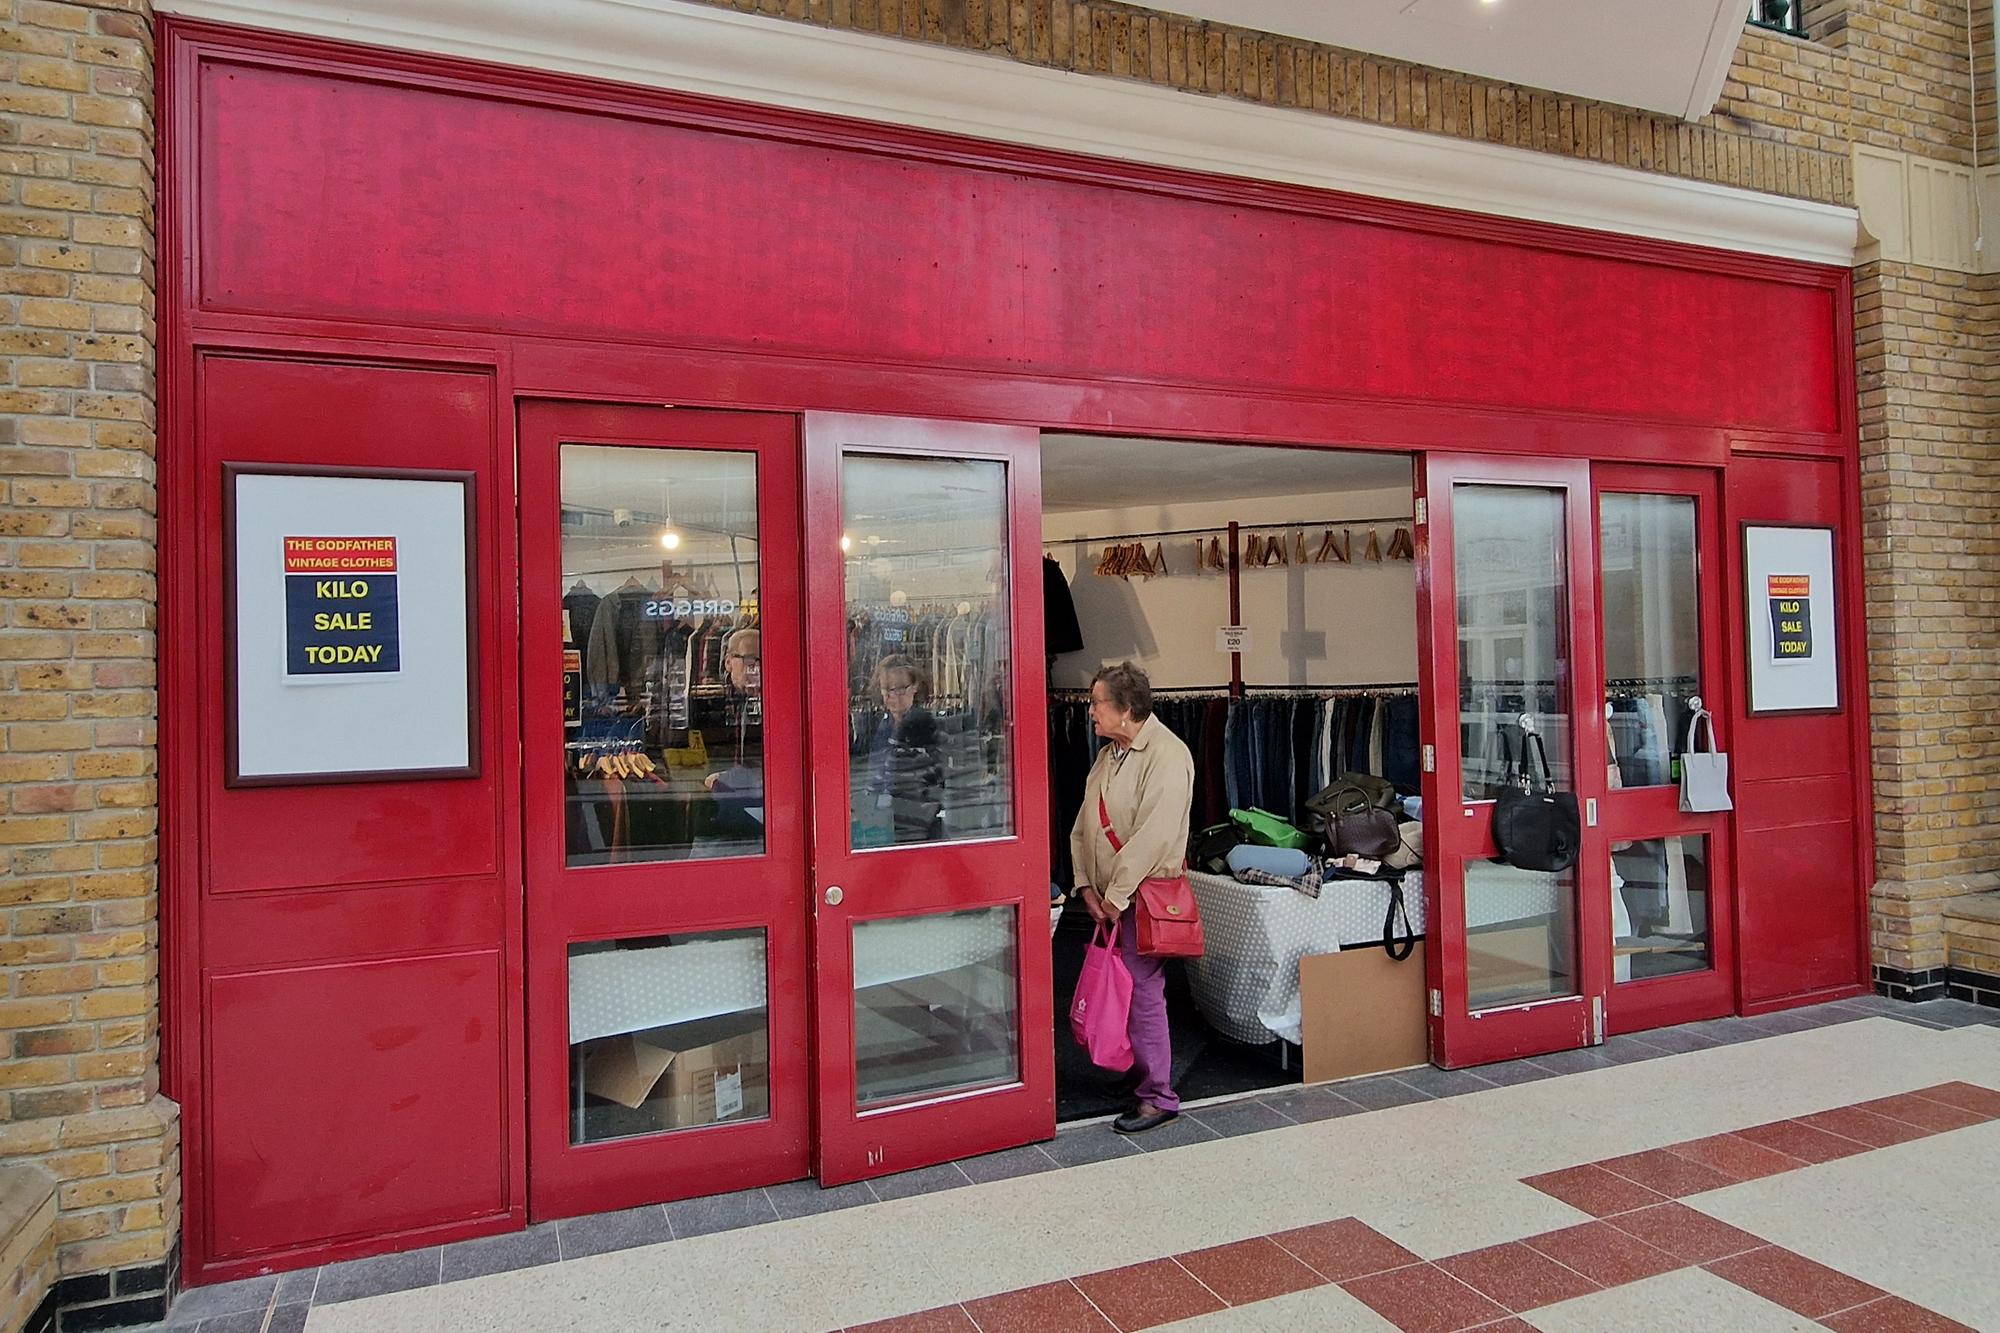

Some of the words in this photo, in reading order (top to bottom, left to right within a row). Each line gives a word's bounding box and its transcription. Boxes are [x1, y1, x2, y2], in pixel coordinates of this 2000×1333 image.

[287, 540, 313, 551] THE
[315, 540, 393, 551] GODFATHER
[287, 558, 339, 567] VINTAGE
[340, 558, 394, 567] CLOTHES
[316, 580, 369, 598] KILO
[1780, 601, 1800, 613] KILO
[314, 612, 372, 631] SALE
[1781, 621, 1803, 633] SALE
[1779, 641, 1807, 653] TODAY
[304, 644, 383, 664] TODAY
